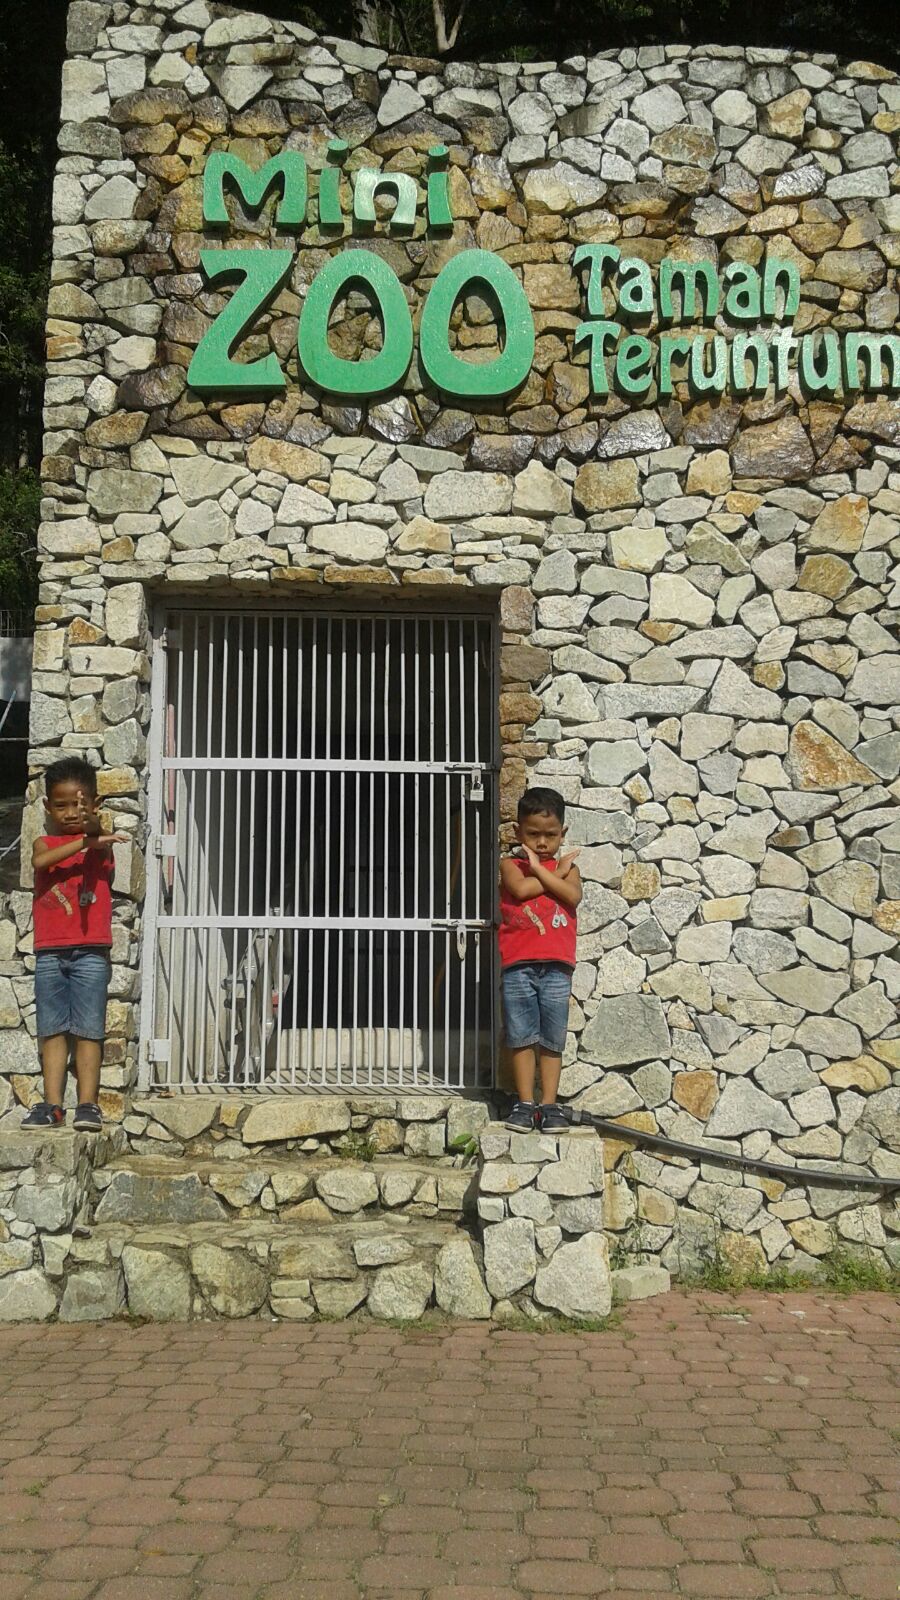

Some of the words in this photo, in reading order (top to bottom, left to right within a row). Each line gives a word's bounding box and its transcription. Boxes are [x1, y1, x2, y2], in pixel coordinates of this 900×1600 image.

[203, 139, 455, 233] Mini
[573, 243, 802, 322] Taman
[575, 320, 900, 399] Teruntum
